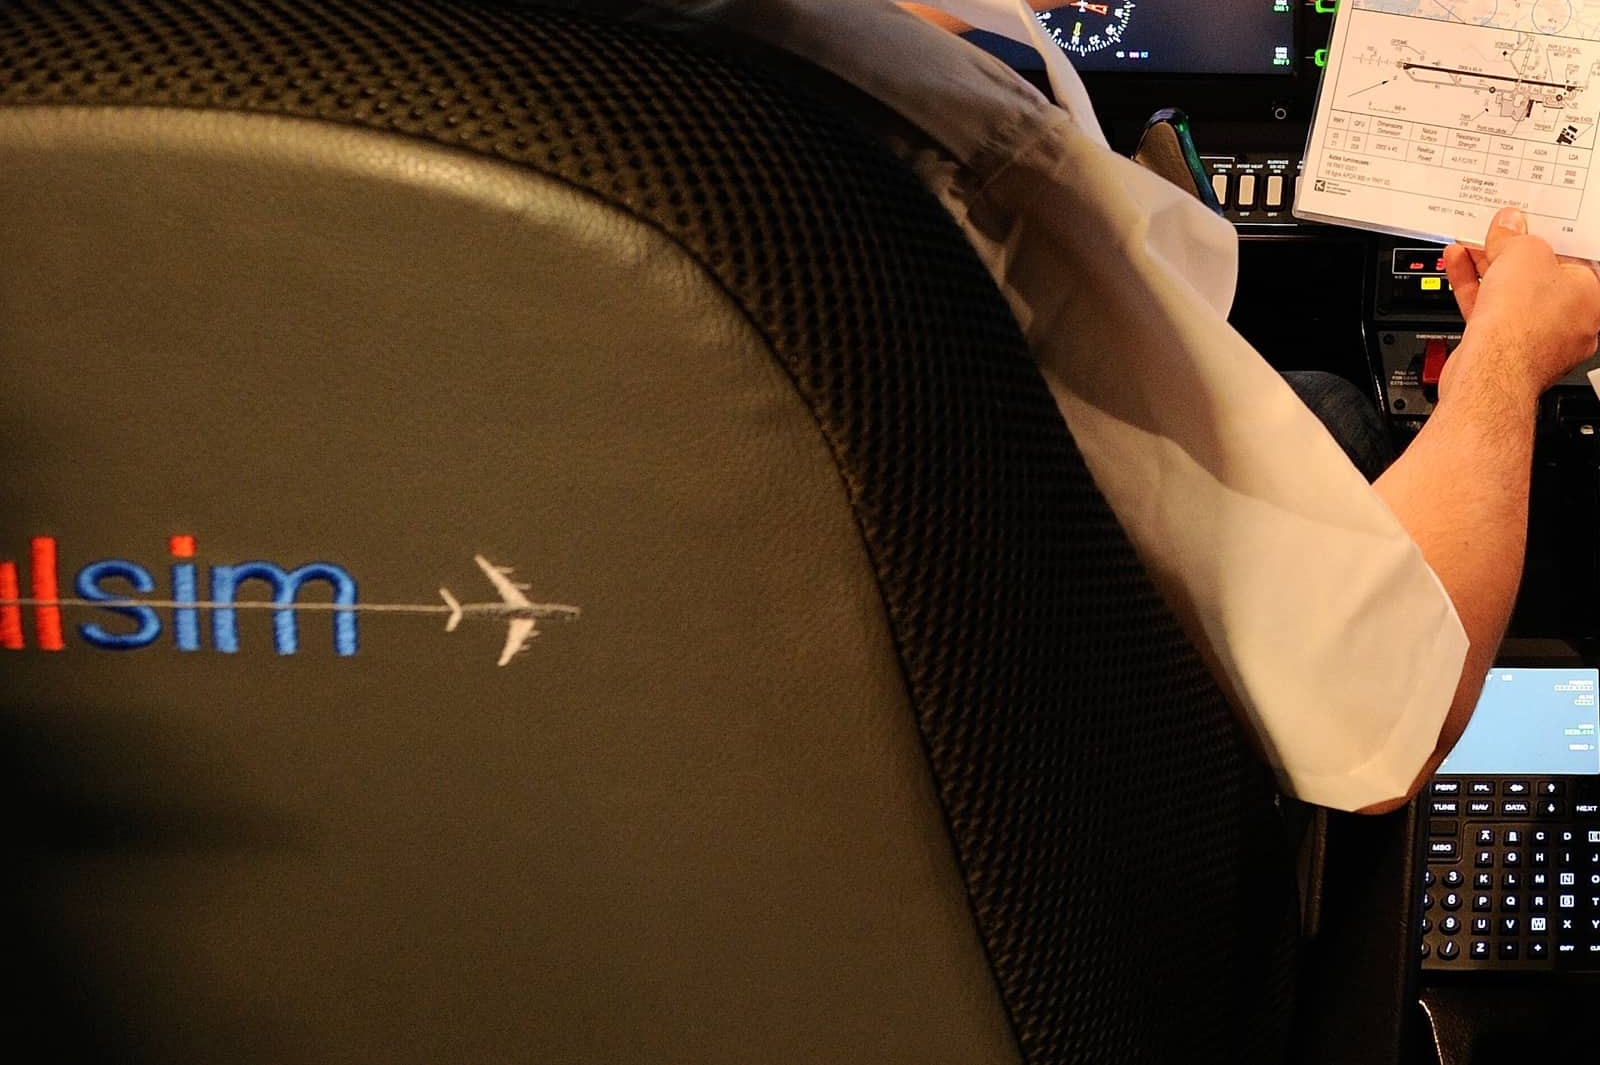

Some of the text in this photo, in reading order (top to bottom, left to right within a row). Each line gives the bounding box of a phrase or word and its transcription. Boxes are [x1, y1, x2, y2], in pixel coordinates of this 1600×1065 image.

[1576, 805, 1598, 813] NEXT
[1508, 853, 1516, 862] G
[1535, 875, 1544, 883] M
[1479, 897, 1488, 905] P
[1506, 897, 1515, 905] Q
[1446, 918, 1454, 928] 9
[1506, 920, 1515, 928] V
[1563, 920, 1572, 929] X
[1476, 943, 1484, 952] Z
